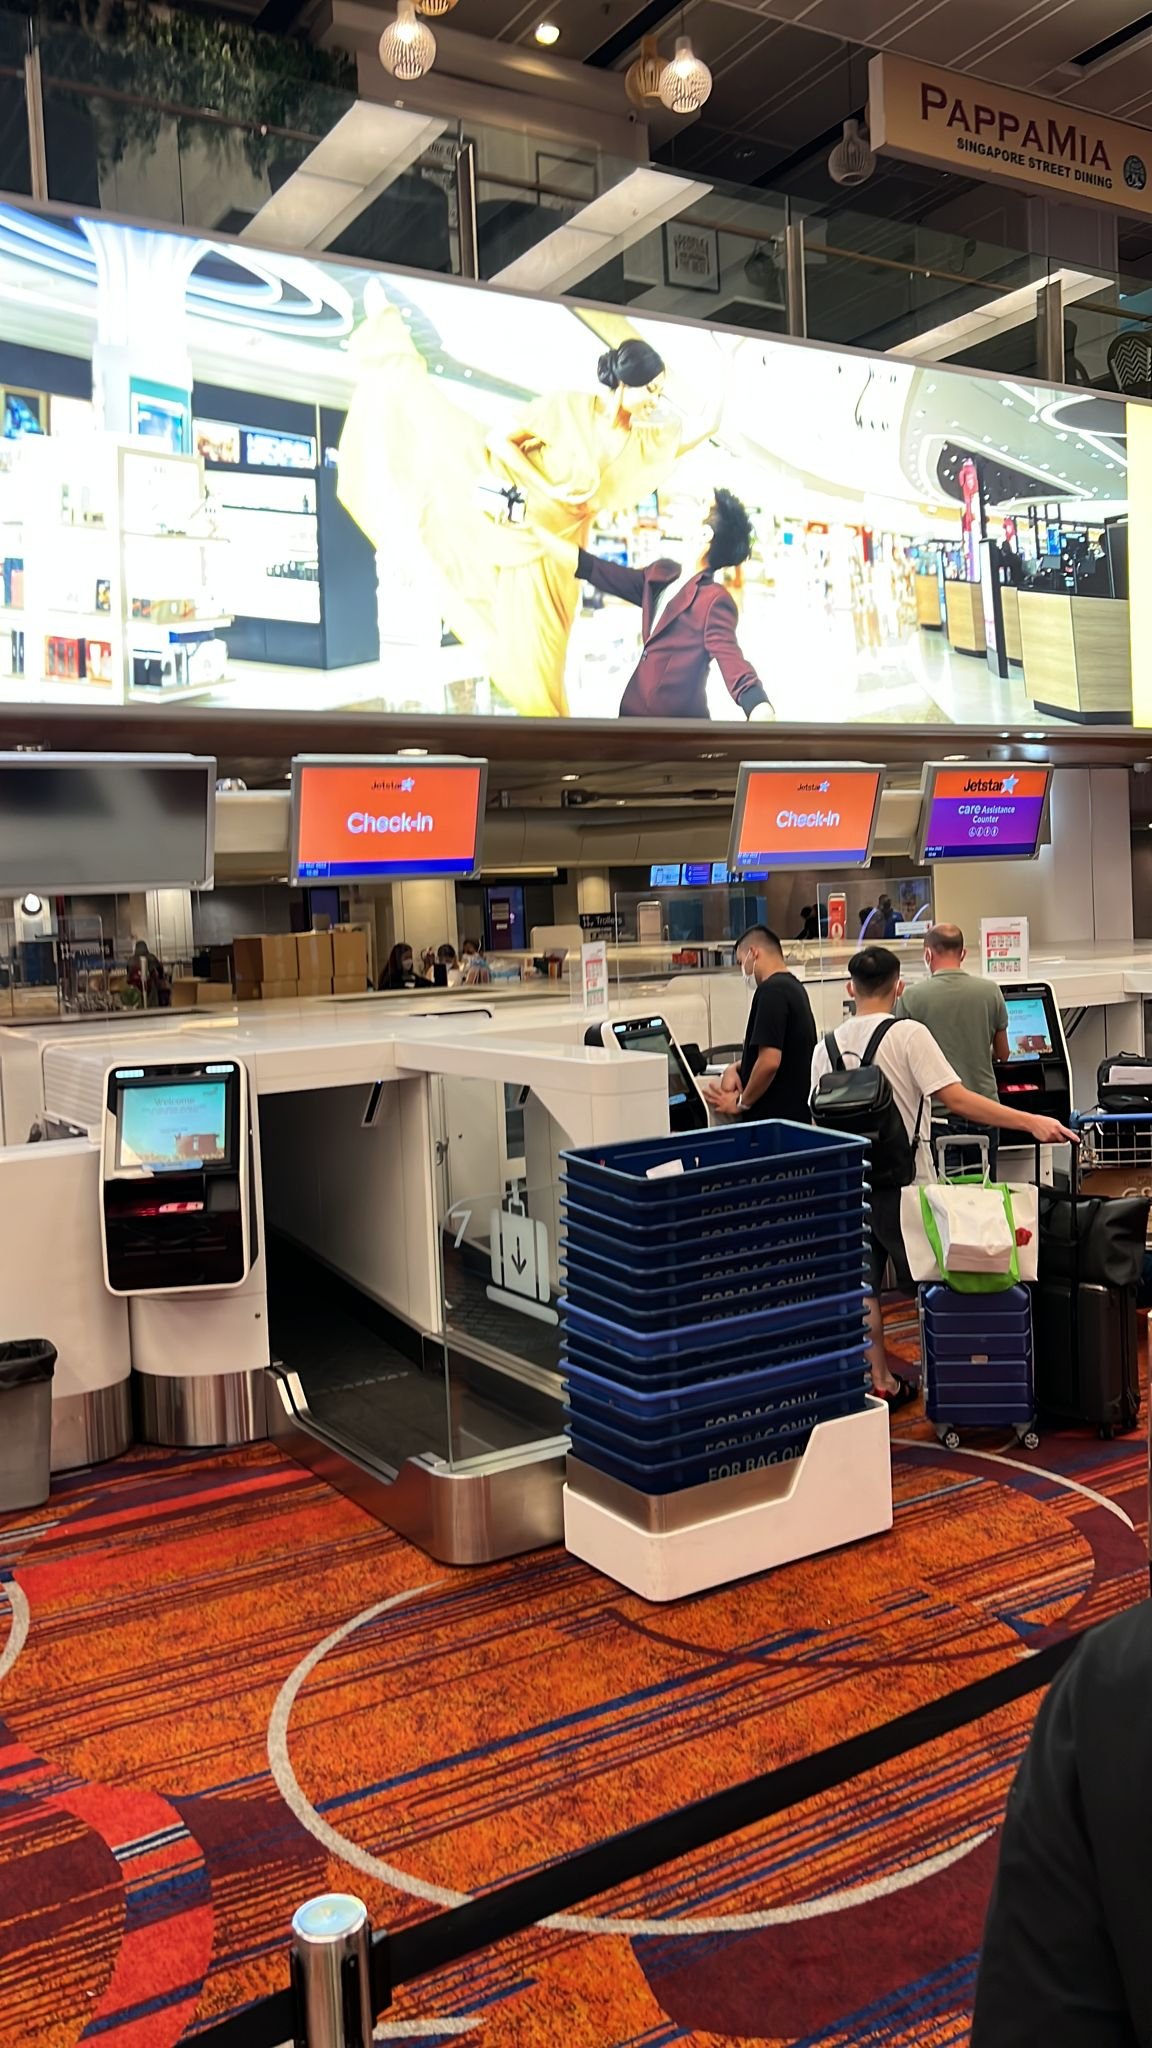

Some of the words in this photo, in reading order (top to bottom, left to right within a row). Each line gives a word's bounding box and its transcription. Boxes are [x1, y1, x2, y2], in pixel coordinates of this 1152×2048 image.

[920, 82, 1113, 171] PAPPAMIA
[956, 137, 1025, 166] SINGAPORE
[1028, 157, 1071, 178] STREET
[1074, 169, 1113, 189] DINING
[371, 780, 403, 790] Jetstar
[797, 783, 821, 792] Jetstar
[964, 778, 1003, 792] Jetstar
[981, 805, 1016, 815] Assistance
[972, 815, 999, 824] Counter
[596, 915, 623, 926] Trolles
[451, 1210, 472, 1248] 7
[708, 1462, 741, 1481] FOR
[745, 1451, 778, 1472] BAG
